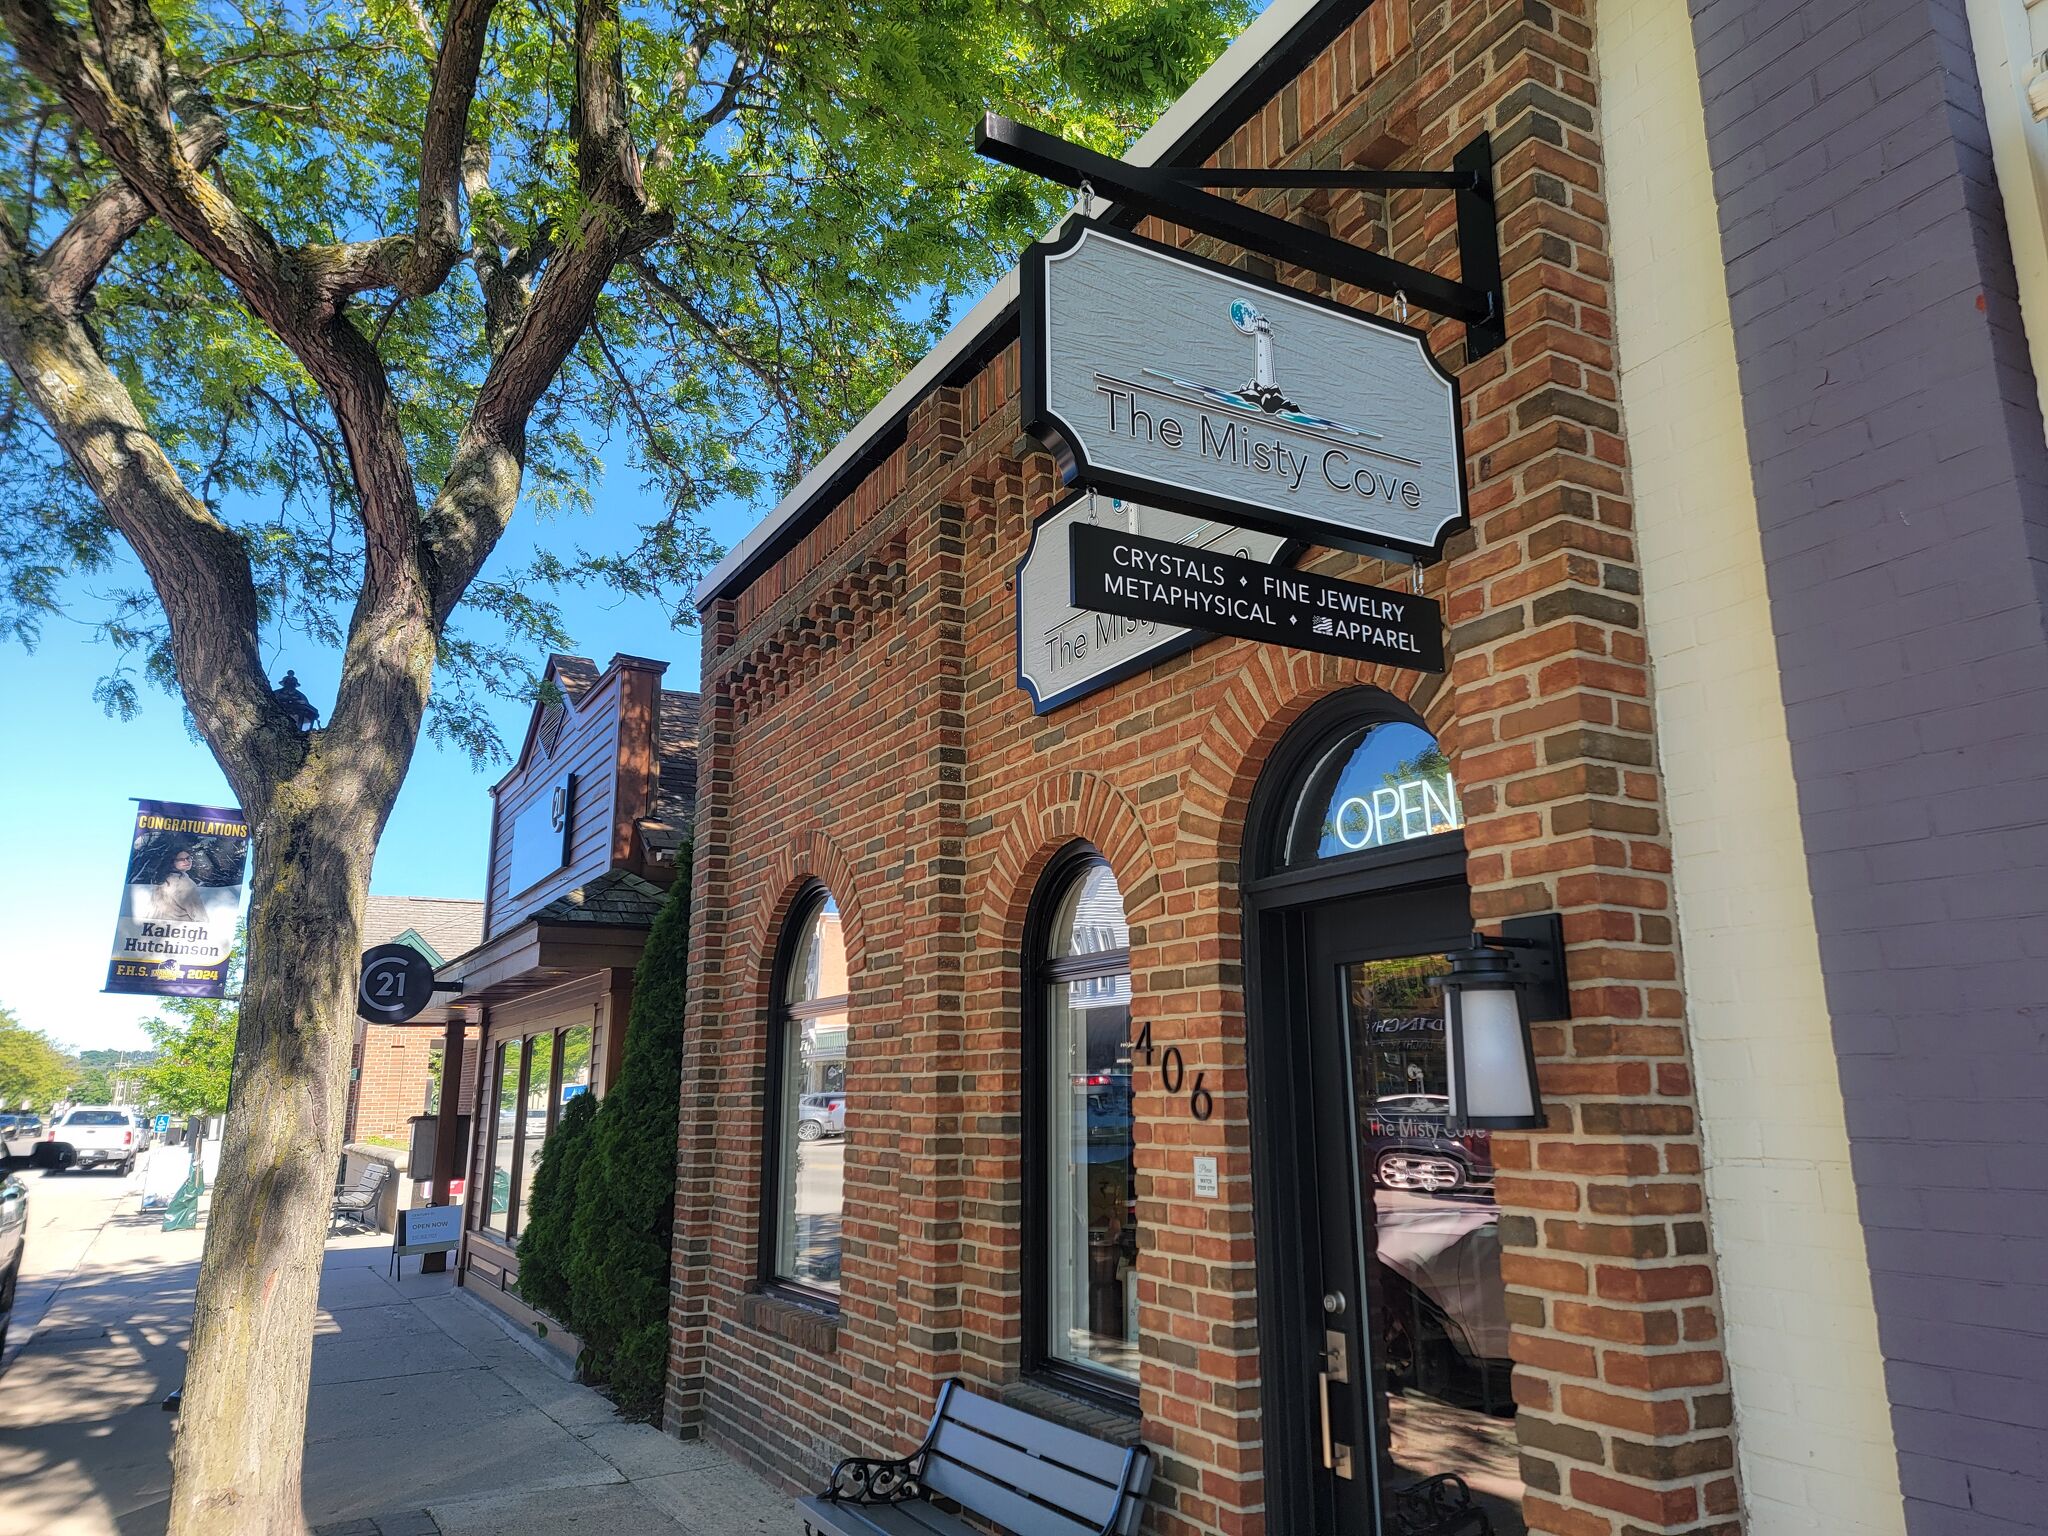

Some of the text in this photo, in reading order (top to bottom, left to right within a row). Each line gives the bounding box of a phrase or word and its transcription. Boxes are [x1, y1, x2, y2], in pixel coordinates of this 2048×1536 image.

[1097, 385, 1422, 509] The Misty Cove
[1113, 545, 1225, 586] CRYSTALS
[1264, 576, 1311, 604] FINE
[1316, 589, 1405, 623] JEWELRY
[1104, 573, 1421, 654] METAPHYSICAL APPAREL
[1044, 612, 1158, 674] The Mis
[138, 815, 247, 838] CONGRATULATIONS
[1336, 772, 1458, 849] OPEN
[124, 938, 219, 957] Hutchinson
[141, 922, 208, 941] Kaleigh
[116, 964, 149, 977] F.H.S.
[186, 970, 218, 981] 2024
[1366, 1117, 1395, 1136] The
[1400, 1117, 1439, 1142] Misty
